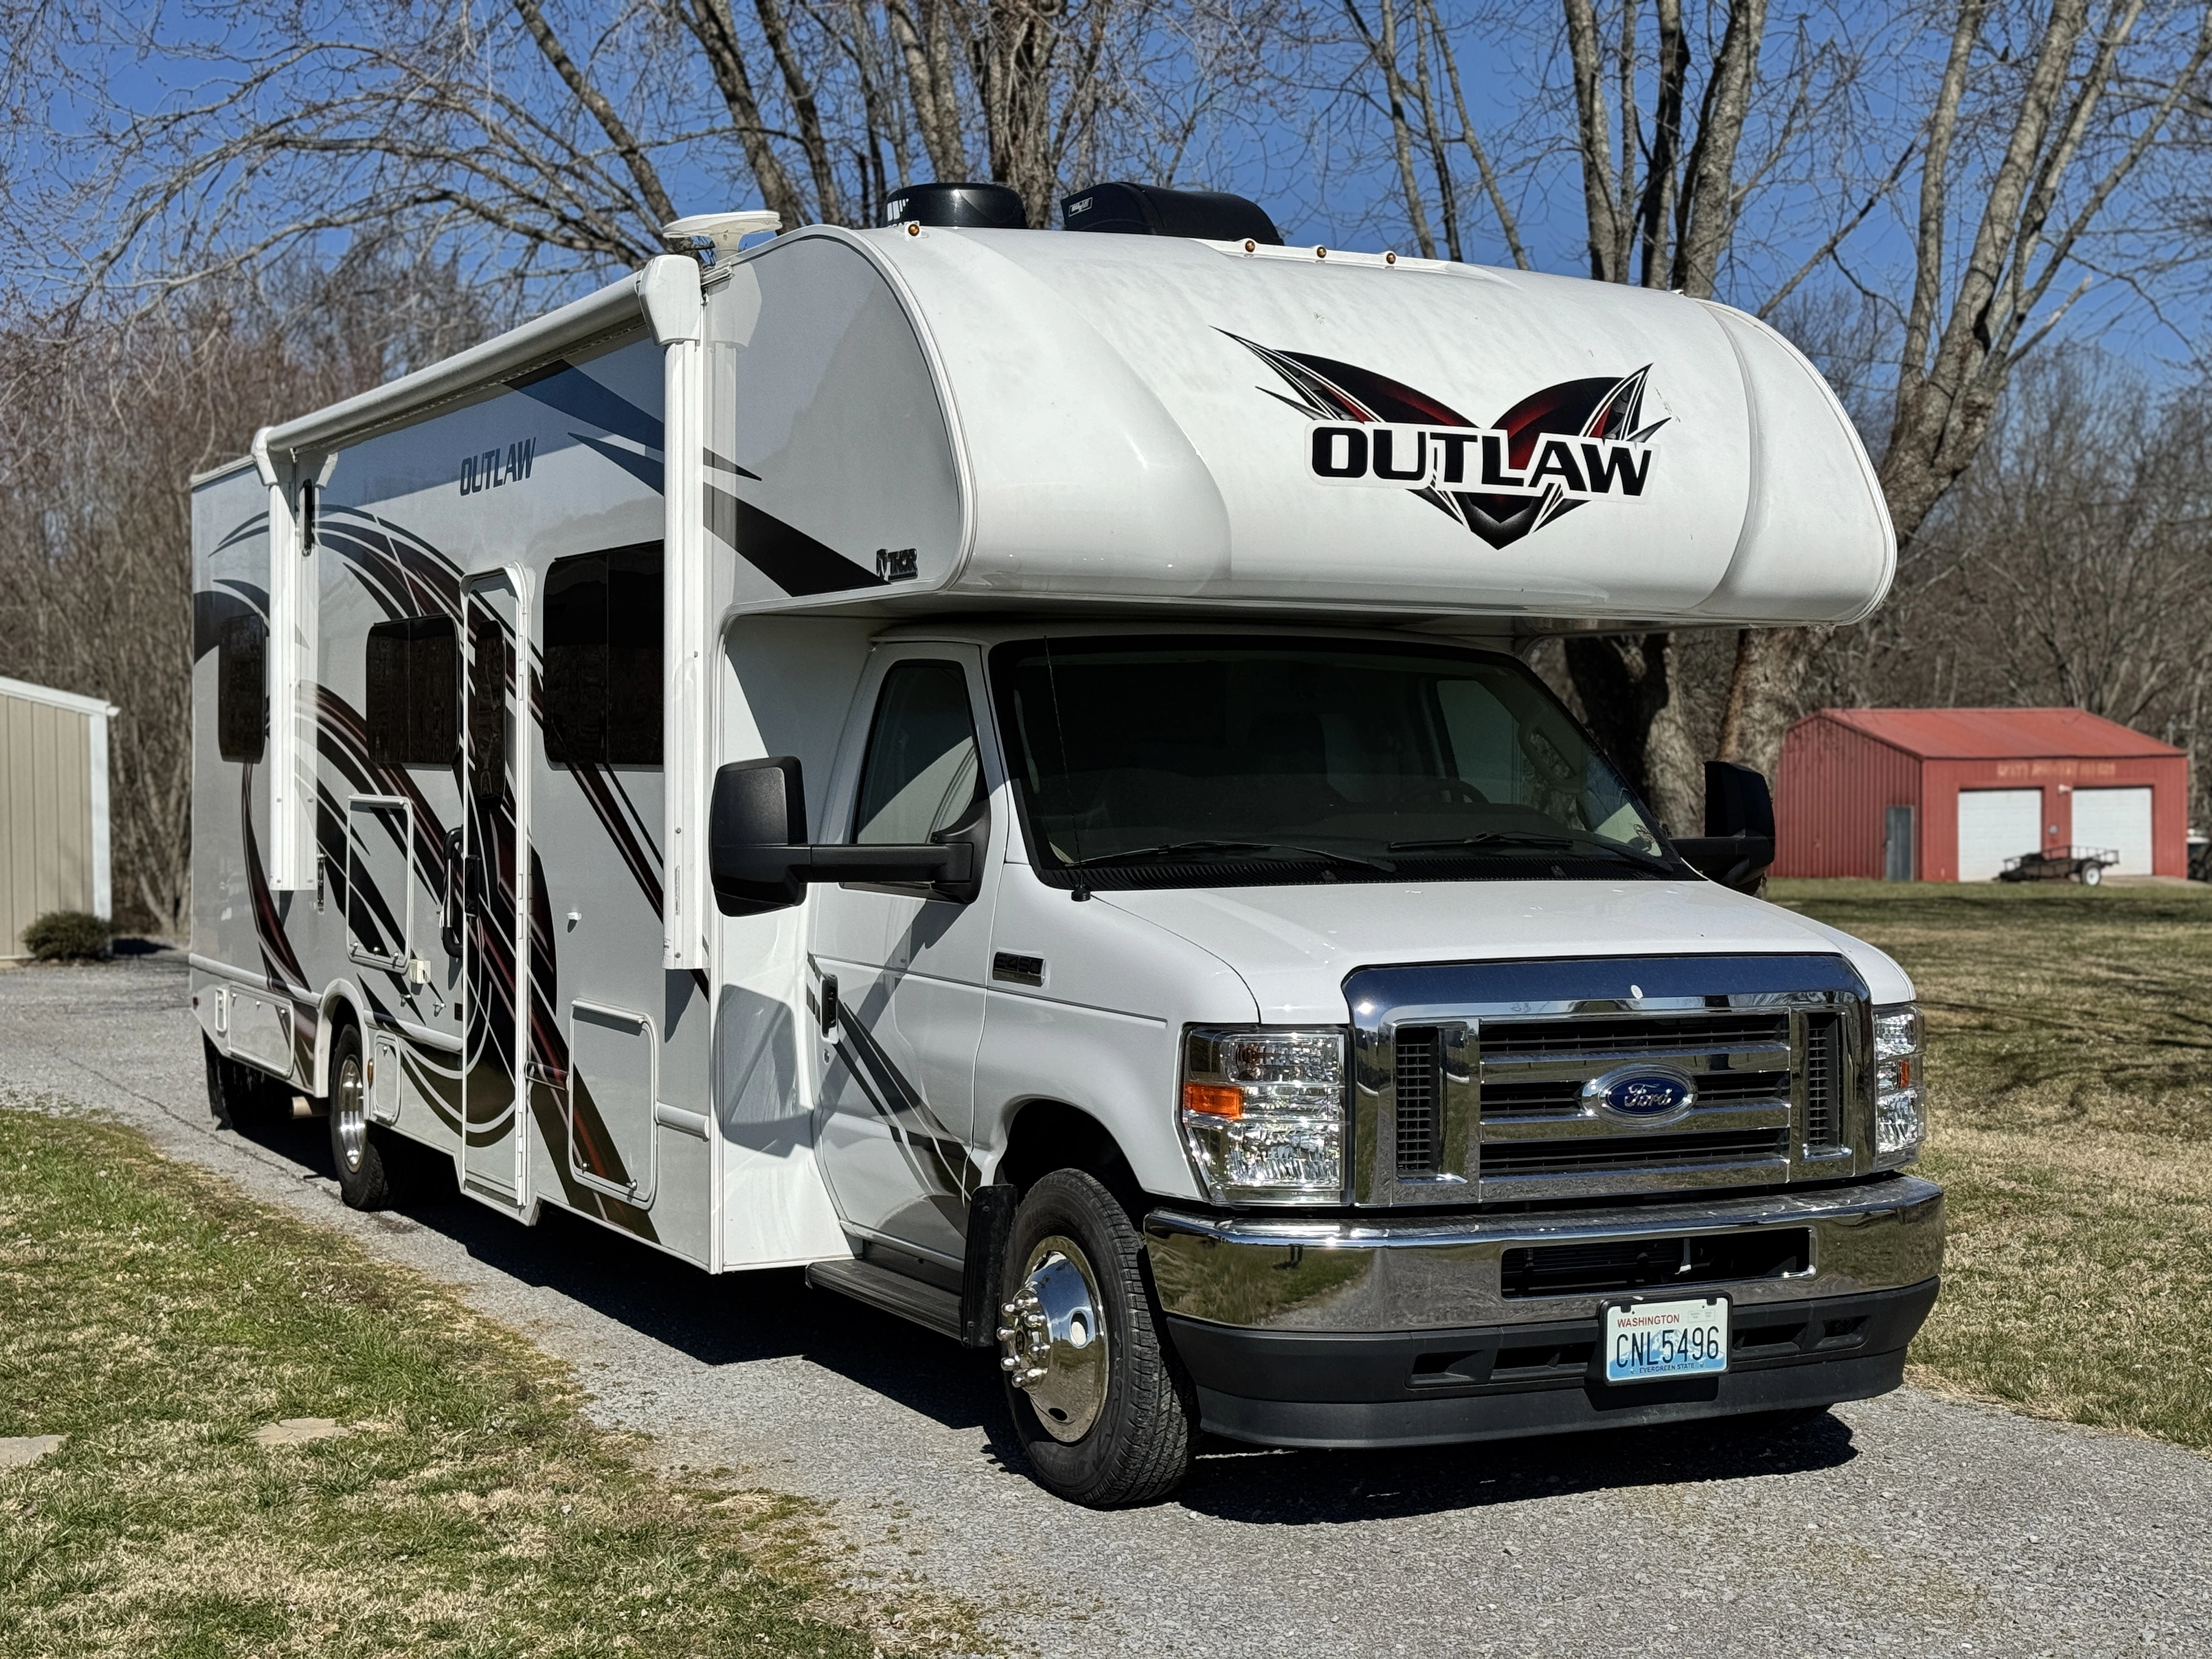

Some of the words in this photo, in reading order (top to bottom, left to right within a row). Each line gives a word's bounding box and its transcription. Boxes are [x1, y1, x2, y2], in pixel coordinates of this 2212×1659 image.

[460, 437, 536, 496] OUTLAW
[1312, 426, 1652, 496] OUTLAW
[1624, 1083, 1672, 1107] Ford
[1617, 1314, 1680, 1328] WASHINGTON
[1616, 1325, 1719, 1368] CNL5496
[1639, 1364, 1676, 1373] EVERGREEN
